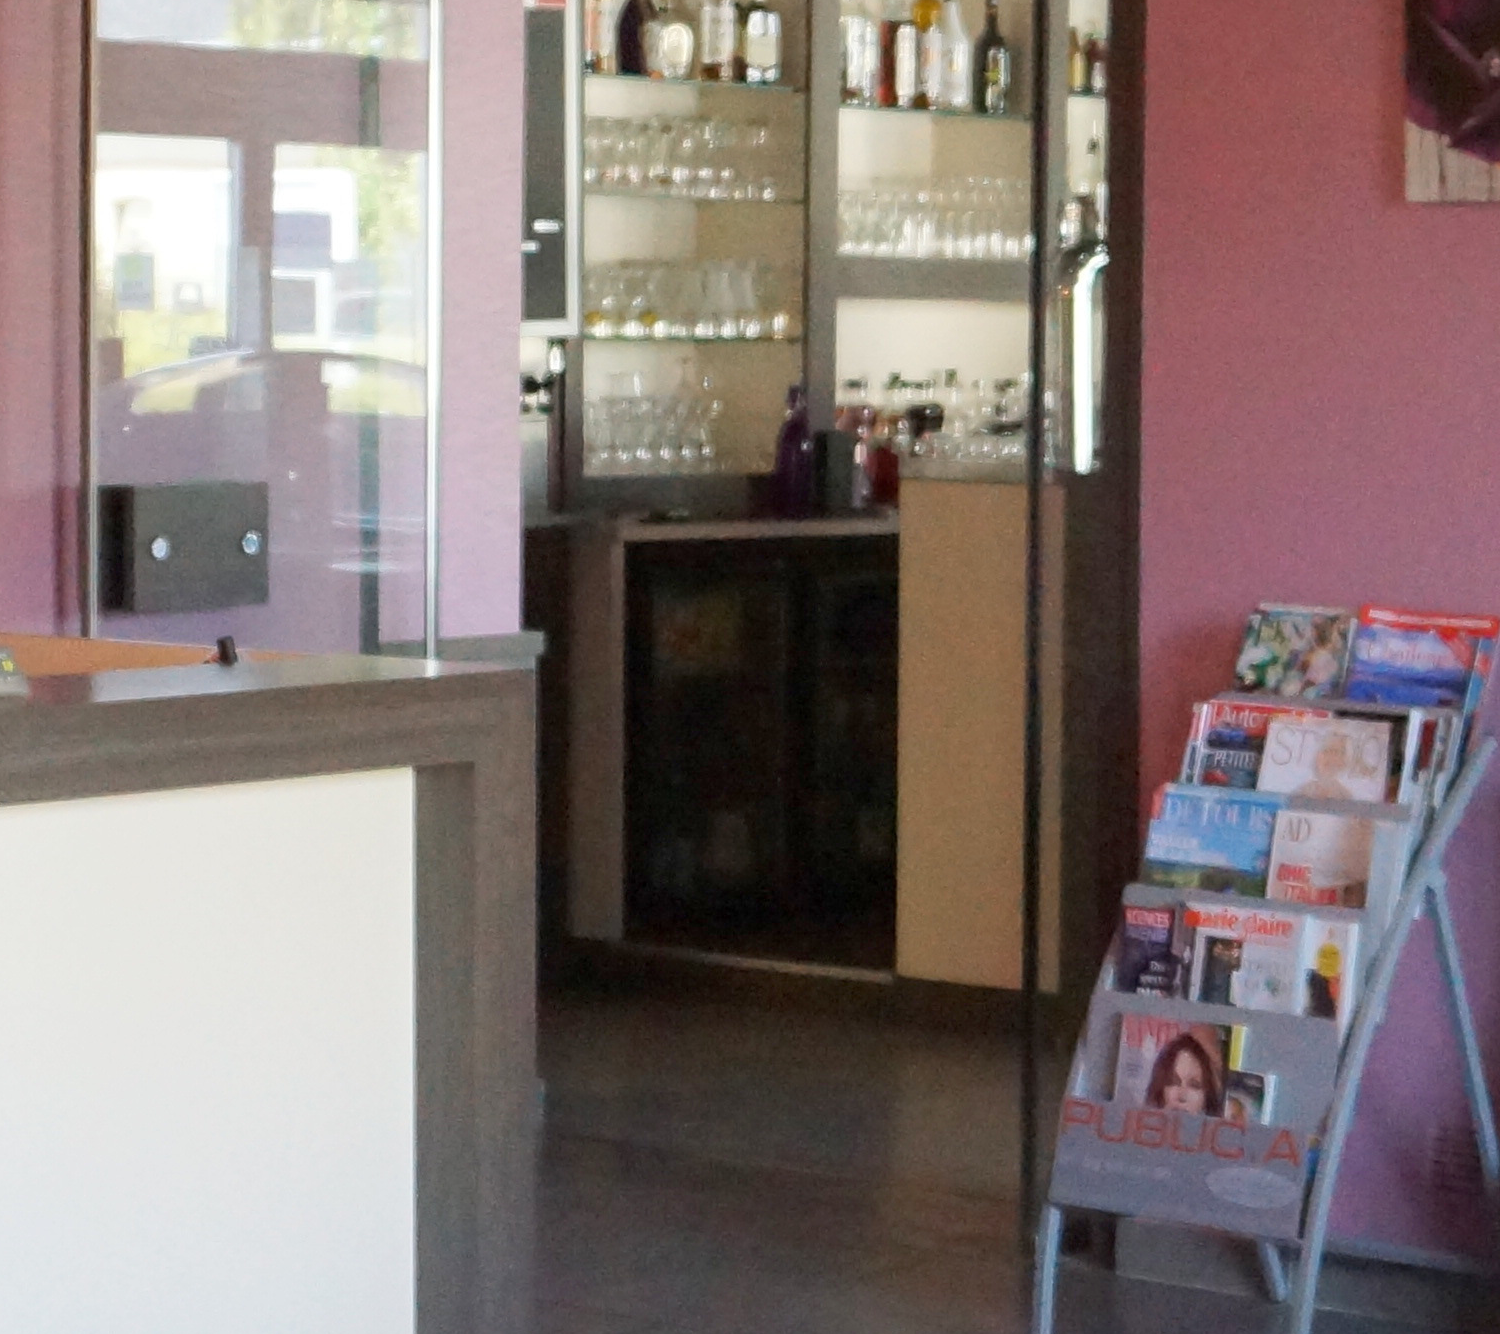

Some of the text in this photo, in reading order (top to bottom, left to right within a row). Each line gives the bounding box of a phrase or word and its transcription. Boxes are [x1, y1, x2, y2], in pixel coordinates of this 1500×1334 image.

[1184, 906, 1294, 939] arie claire
[1062, 1097, 1302, 1167] PUBLIC A
